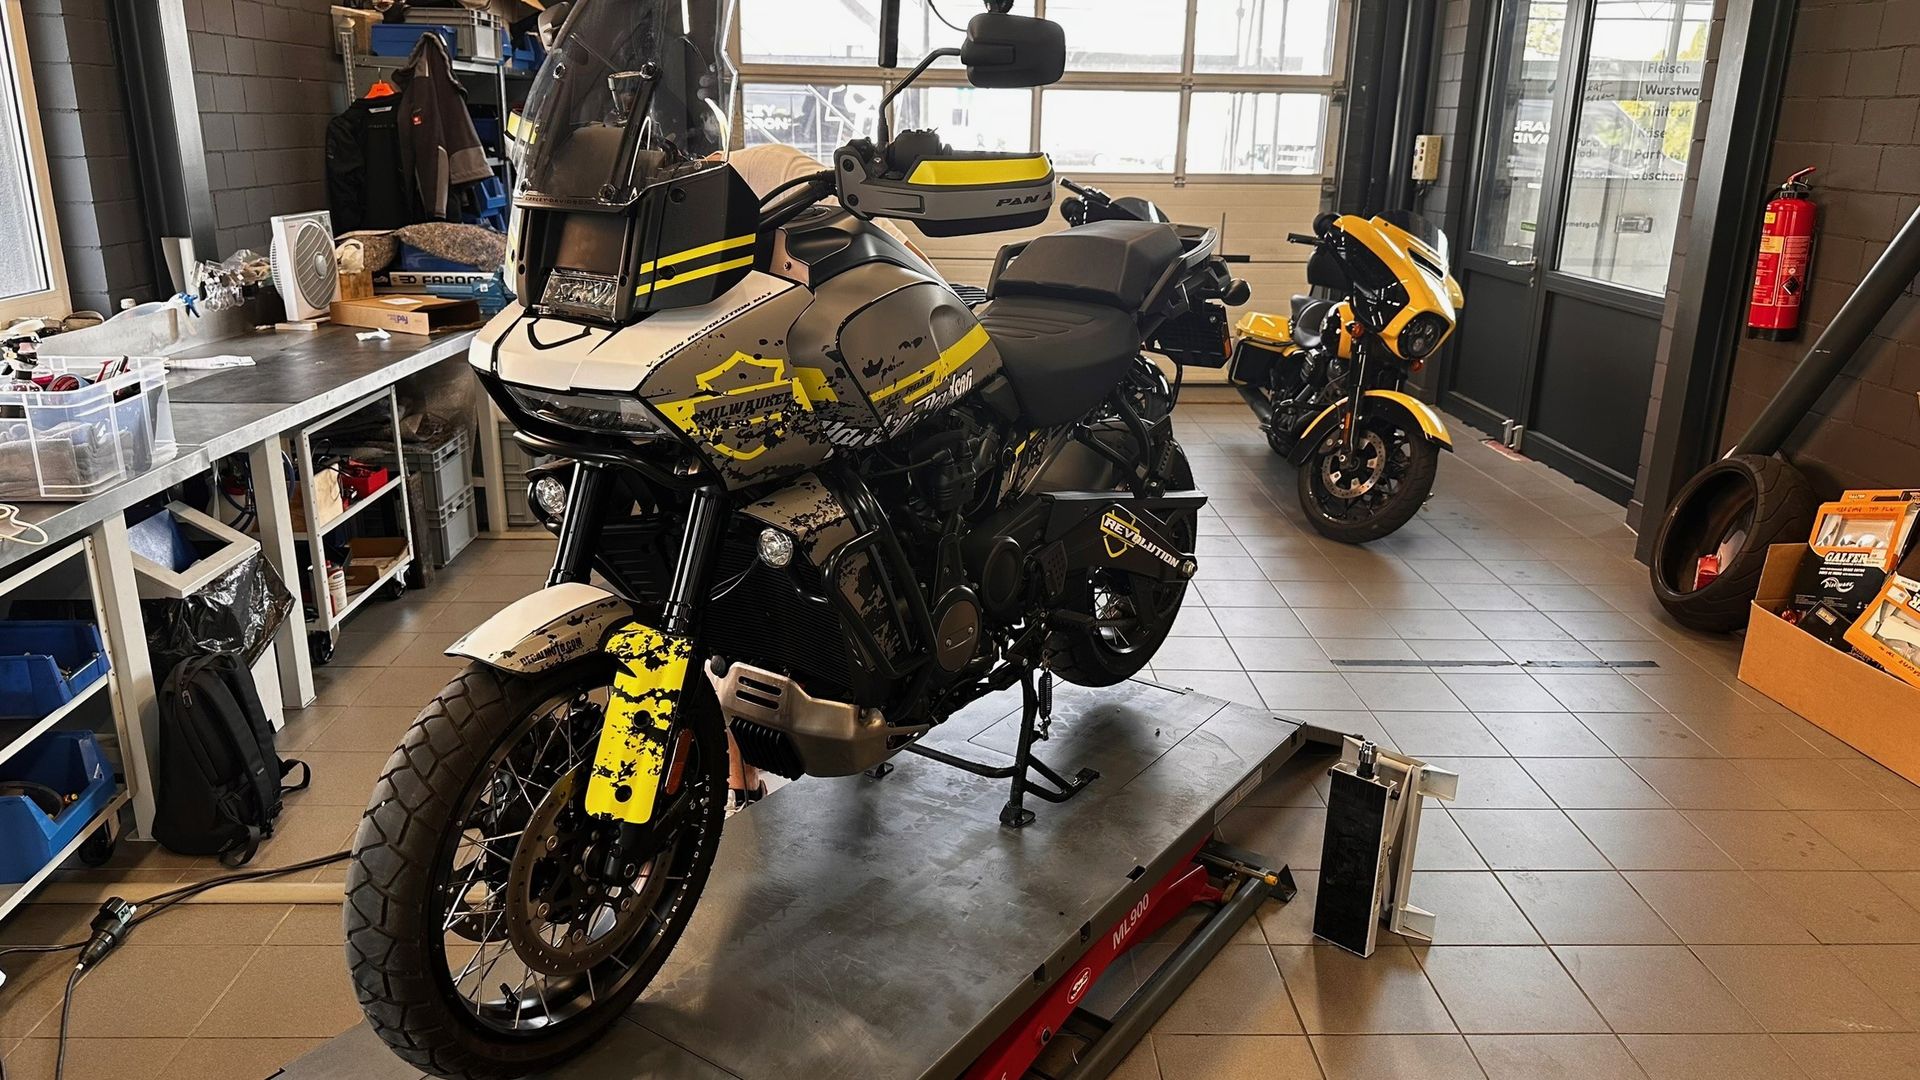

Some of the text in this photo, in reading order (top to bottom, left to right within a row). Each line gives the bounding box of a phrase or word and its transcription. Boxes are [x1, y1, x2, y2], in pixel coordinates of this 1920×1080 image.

[1648, 62, 1690, 75] Fleisch
[1645, 84, 1700, 97] Wurstwa
[996, 194, 1039, 207] PAN
[646, 291, 772, 367] V-TWIN REVOLUTION MAX
[905, 375, 932, 394] ROAD
[700, 392, 795, 422] MILWAUKEE
[1104, 516, 1179, 568] REVOLUTION
[1825, 552, 1869, 564] GALFER
[1112, 892, 1149, 950] ML900
